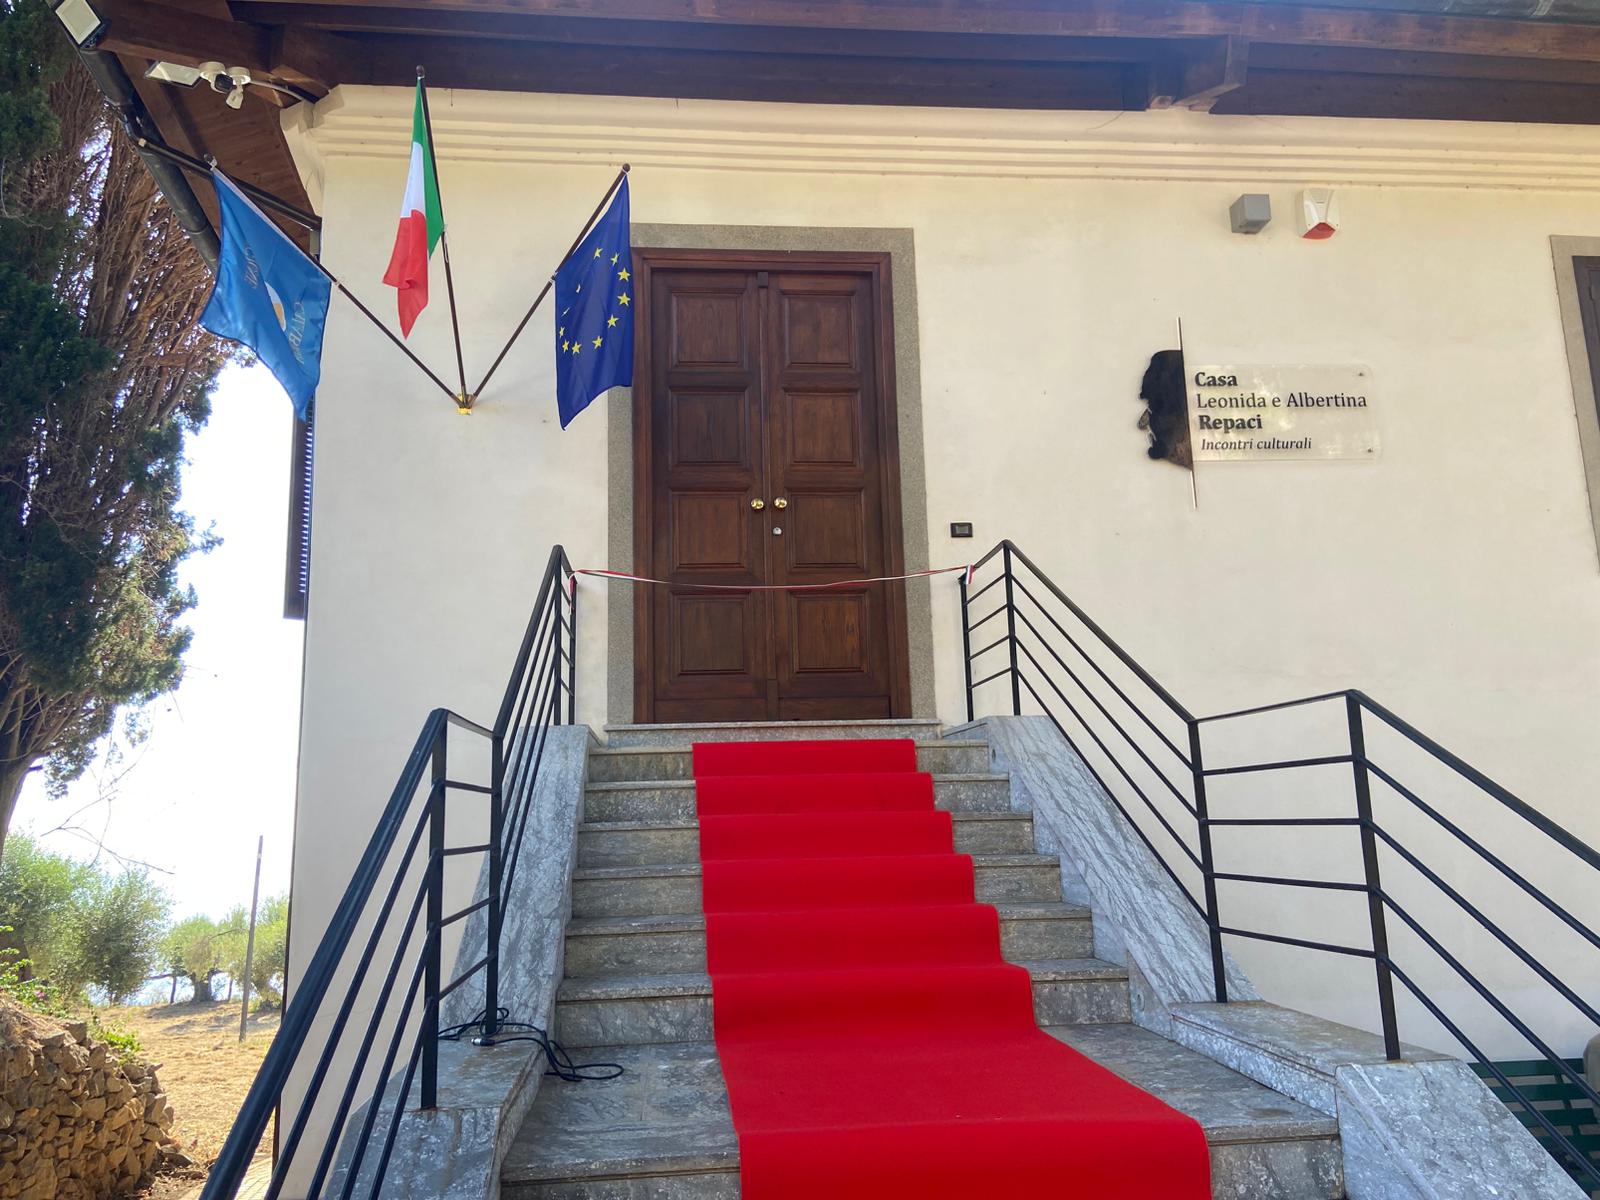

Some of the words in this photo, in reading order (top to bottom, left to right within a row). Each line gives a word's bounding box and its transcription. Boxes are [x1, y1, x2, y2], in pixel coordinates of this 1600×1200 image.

[1194, 371, 1238, 387] Casa
[1196, 393, 1267, 409] Leonida
[1272, 395, 1281, 408] e
[1286, 392, 1368, 408] Albertina
[1198, 414, 1263, 433] Repaci
[1201, 438, 1253, 451] Incontri
[1256, 437, 1313, 450] culturali
